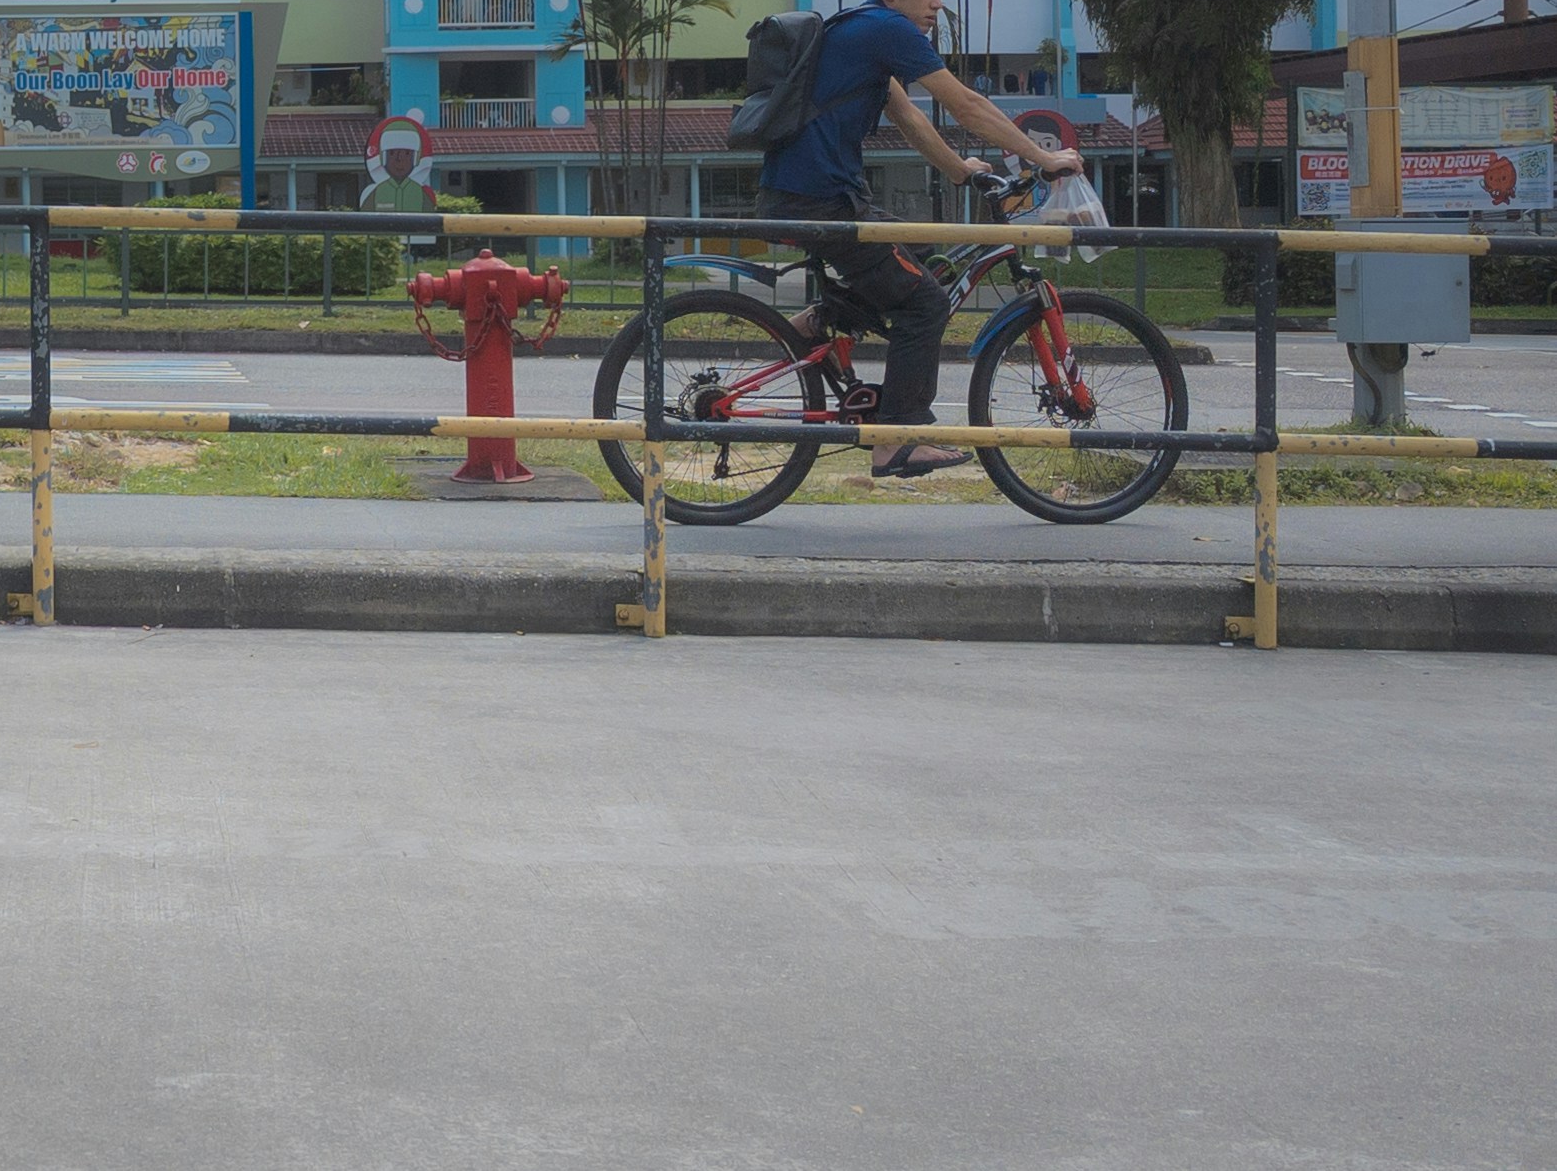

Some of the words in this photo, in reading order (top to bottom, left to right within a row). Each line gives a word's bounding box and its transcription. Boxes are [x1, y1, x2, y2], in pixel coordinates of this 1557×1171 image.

[15, 34, 26, 51] A
[30, 32, 86, 51] WARM
[89, 29, 173, 50] WELCOME
[177, 28, 226, 48] HOME
[16, 71, 48, 91] Our
[52, 70, 99, 90] Boon
[104, 69, 134, 91] Lay
[137, 69, 171, 88] Our
[174, 67, 227, 87] Home
[1307, 157, 1348, 170] BLOO
[1444, 154, 1491, 168] DRIVE
